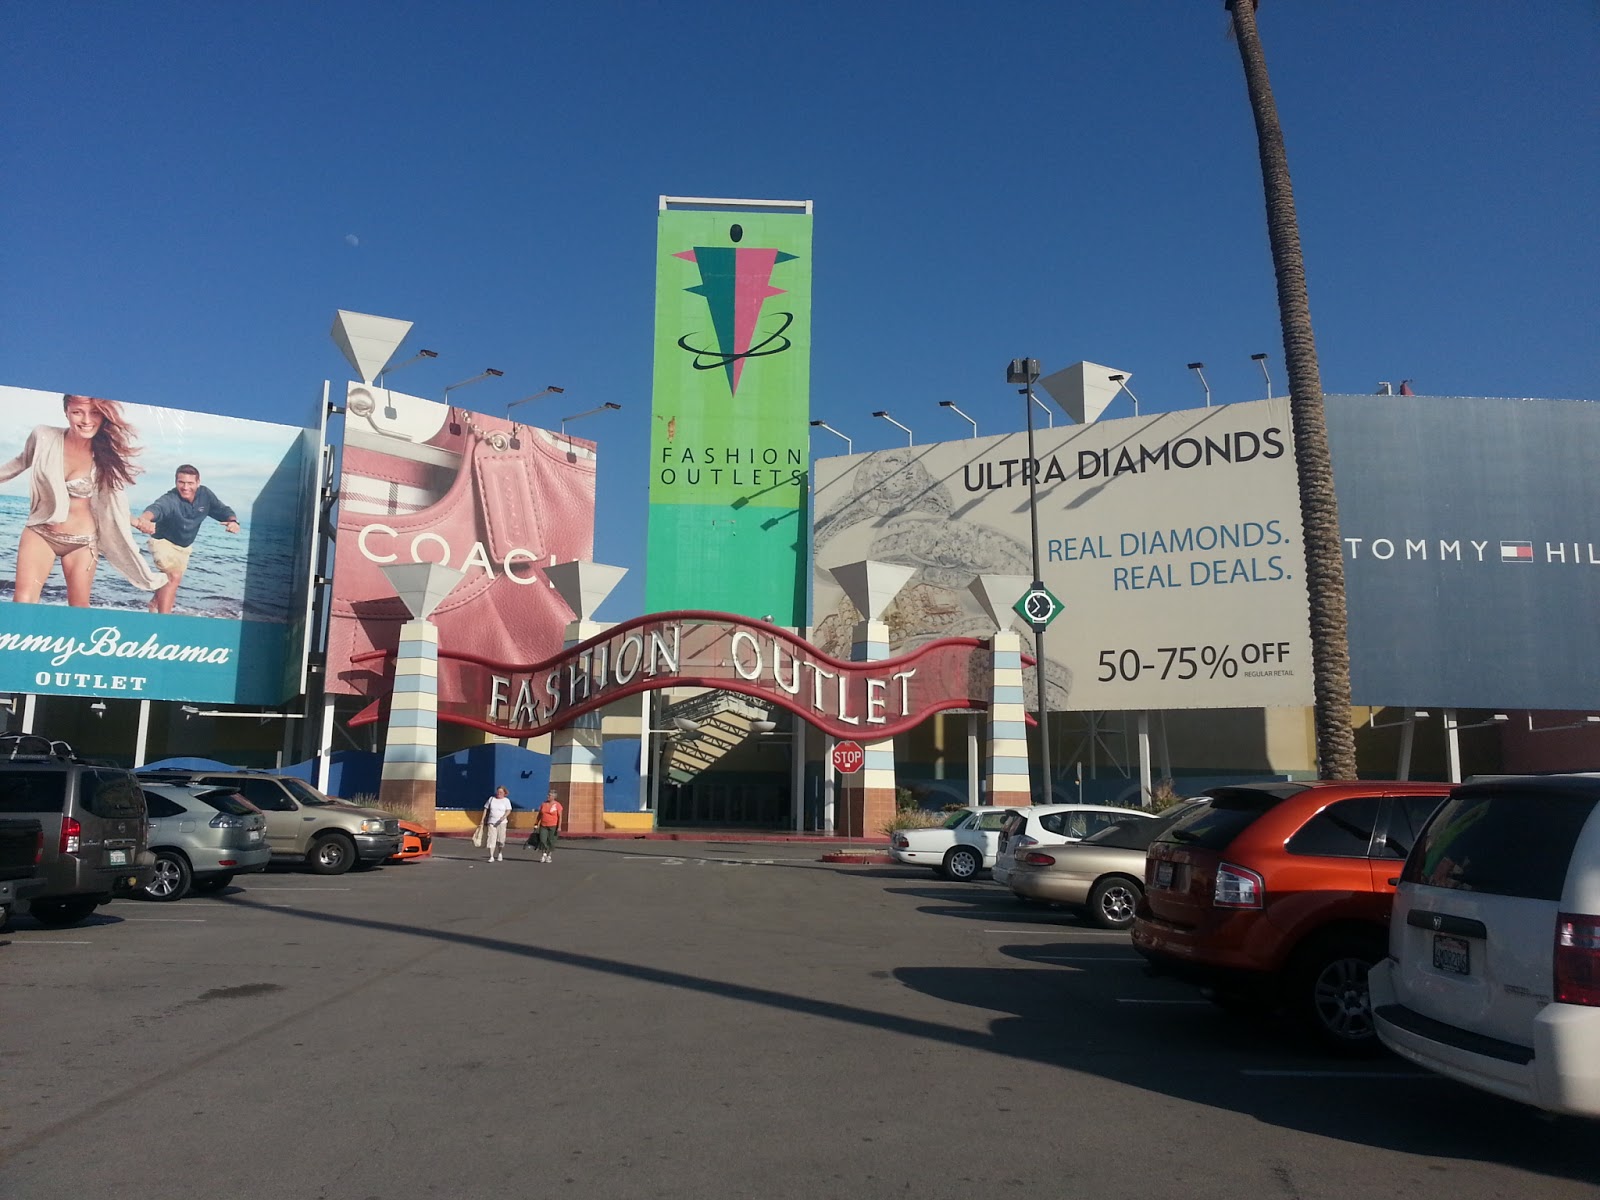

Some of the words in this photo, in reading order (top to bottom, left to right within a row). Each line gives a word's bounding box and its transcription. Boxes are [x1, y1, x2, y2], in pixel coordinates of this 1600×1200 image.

[662, 447, 801, 465] FASHION
[963, 454, 1067, 492] ULTRA
[1078, 428, 1285, 480] DIAMONDS
[660, 468, 801, 486] OUTLETS
[358, 523, 579, 589] COAC
[1048, 535, 1112, 563] REAL
[1120, 520, 1291, 557] DIAMONDS.
[1344, 538, 1488, 562] TOMMY
[1113, 565, 1182, 591] REAL
[1190, 556, 1293, 587] DEALS.
[79, 626, 231, 665] Bahama
[1098, 644, 1238, 682] 50-75%
[1241, 642, 1290, 664] OFF
[35, 671, 147, 691] OUTLET
[489, 624, 682, 723] FASHION
[731, 630, 916, 726] OUTLET
[833, 751, 862, 764] STOP
